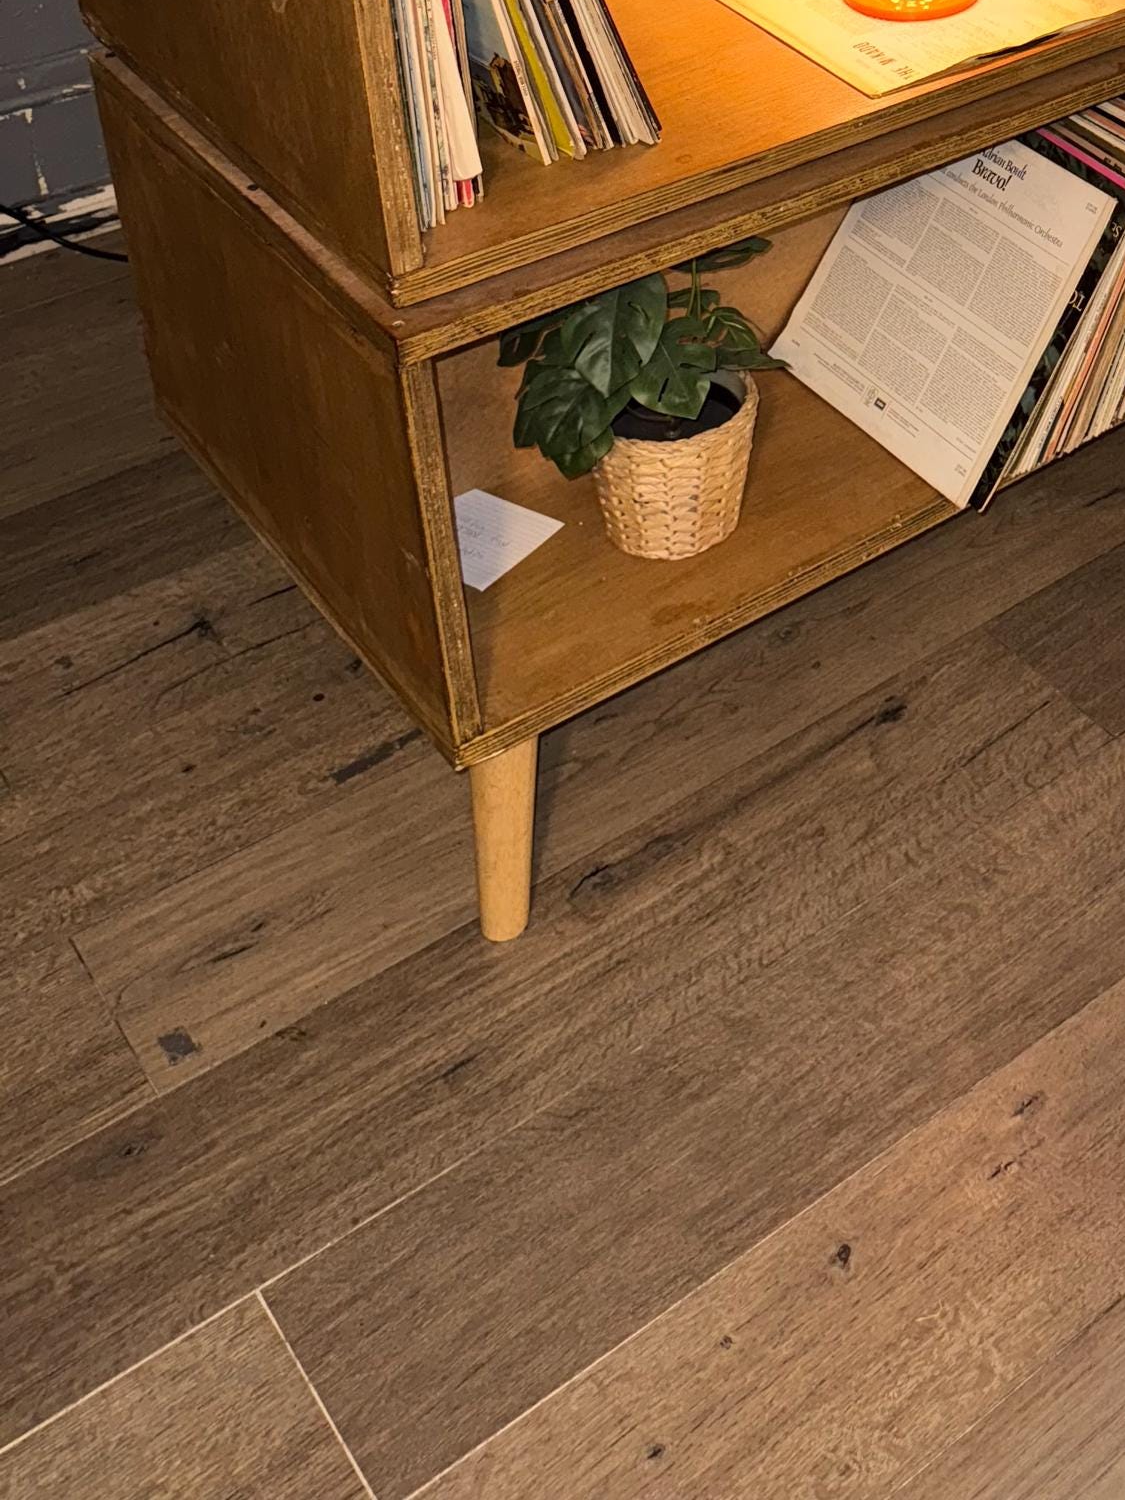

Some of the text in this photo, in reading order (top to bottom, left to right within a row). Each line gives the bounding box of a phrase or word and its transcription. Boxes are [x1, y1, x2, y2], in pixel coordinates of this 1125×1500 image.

[972, 158, 1013, 192] Bravo!
[977, 188, 998, 207] London
[999, 201, 1034, 230] Philharmonic
[1034, 224, 1063, 249] Orchestra
